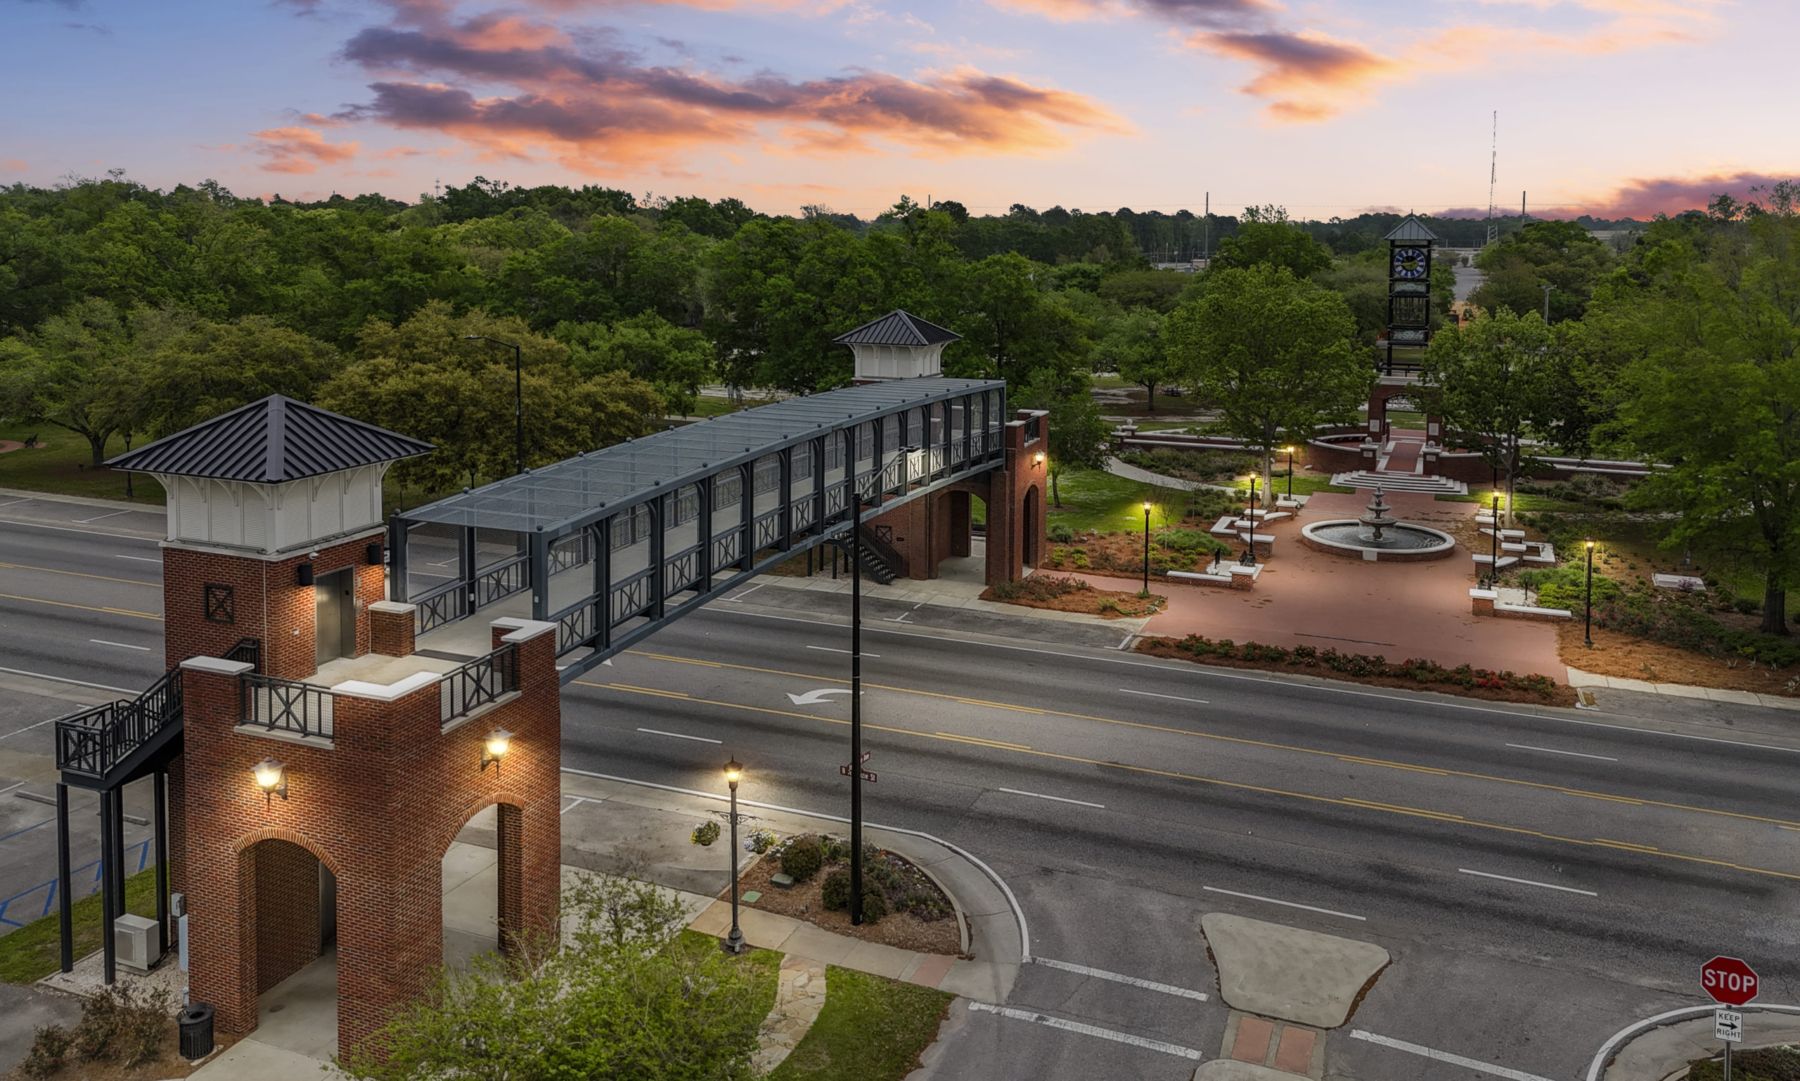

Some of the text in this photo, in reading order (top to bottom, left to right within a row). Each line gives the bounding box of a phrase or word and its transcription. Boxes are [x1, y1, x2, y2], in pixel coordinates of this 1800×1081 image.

[1704, 968, 1755, 993] STOP
[1718, 1012, 1740, 1022] KEEP
[1716, 1028, 1741, 1038] RIGHT
